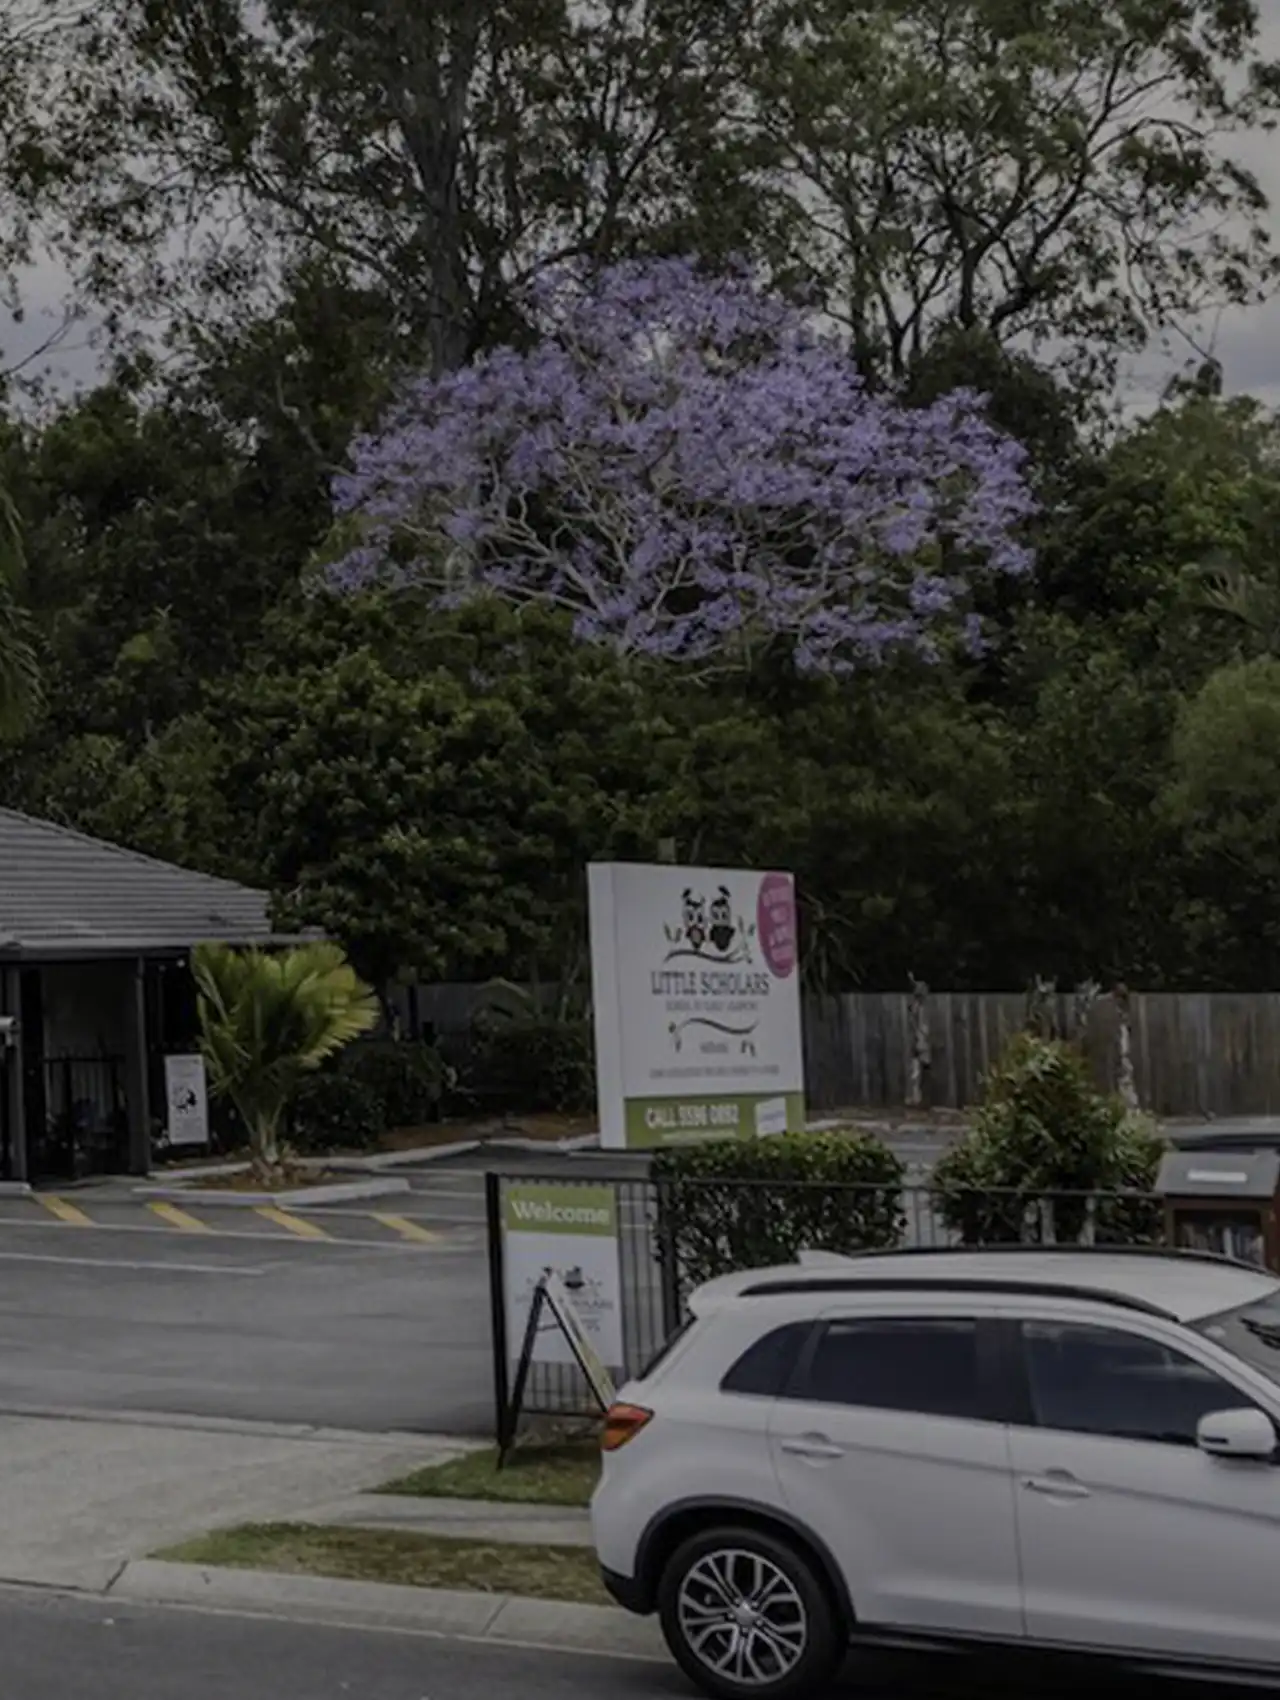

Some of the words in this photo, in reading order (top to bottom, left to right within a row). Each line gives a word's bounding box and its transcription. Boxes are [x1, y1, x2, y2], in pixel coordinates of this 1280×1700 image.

[651, 970, 697, 996] LITTLE
[700, 970, 770, 996] SCHOLARS
[645, 1106, 677, 1129] CALL
[511, 1201, 611, 1226] Welcome
